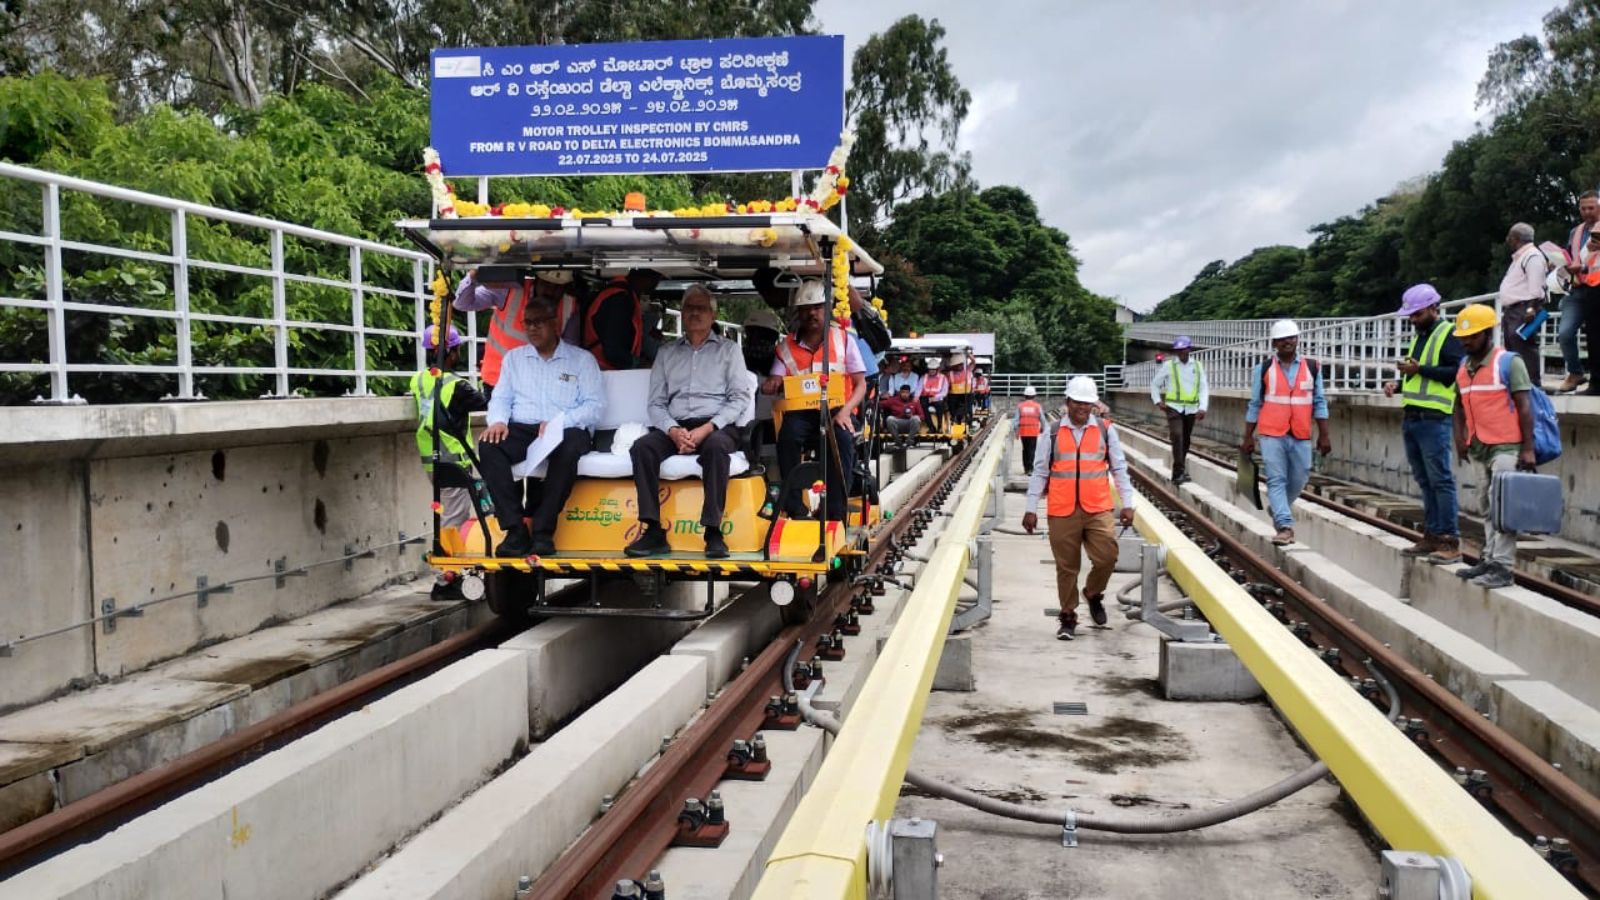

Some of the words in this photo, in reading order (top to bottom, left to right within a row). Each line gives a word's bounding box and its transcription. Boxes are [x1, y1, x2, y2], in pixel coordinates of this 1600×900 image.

[482, 62, 494, 76] ಸಿ
[501, 63, 523, 75] ಎಂ
[529, 60, 560, 74] ಆರ್
[567, 59, 597, 74] ಎಸ್
[603, 56, 673, 73] ಮೋಟಾರ್
[470, 82, 500, 97] ಆರ್
[507, 82, 519, 96] ವಿ
[525, 79, 593, 99] ರಸ್ತೆಯಿಂದ
[522, 126, 564, 137] MOTOR
[567, 125, 618, 136] TROLLEY
[621, 123, 691, 135] INSPECTION
[695, 122, 710, 132] BY
[713, 121, 748, 132] CMRS
[470, 141, 503, 152] FROM
[507, 142, 515, 152] R
[518, 141, 526, 151] V
[529, 140, 561, 151] ROAD
[564, 140, 578, 150] TO
[582, 139, 617, 150] DELTA
[620, 137, 700, 149] ELECTRONICS
[704, 134, 800, 147] BOMMASANDRA
[558, 154, 621, 165] 22.07.2025
[625, 153, 640, 163] TO
[642, 152, 708, 163] 24.07.2025
[674, 519, 734, 535] meo
